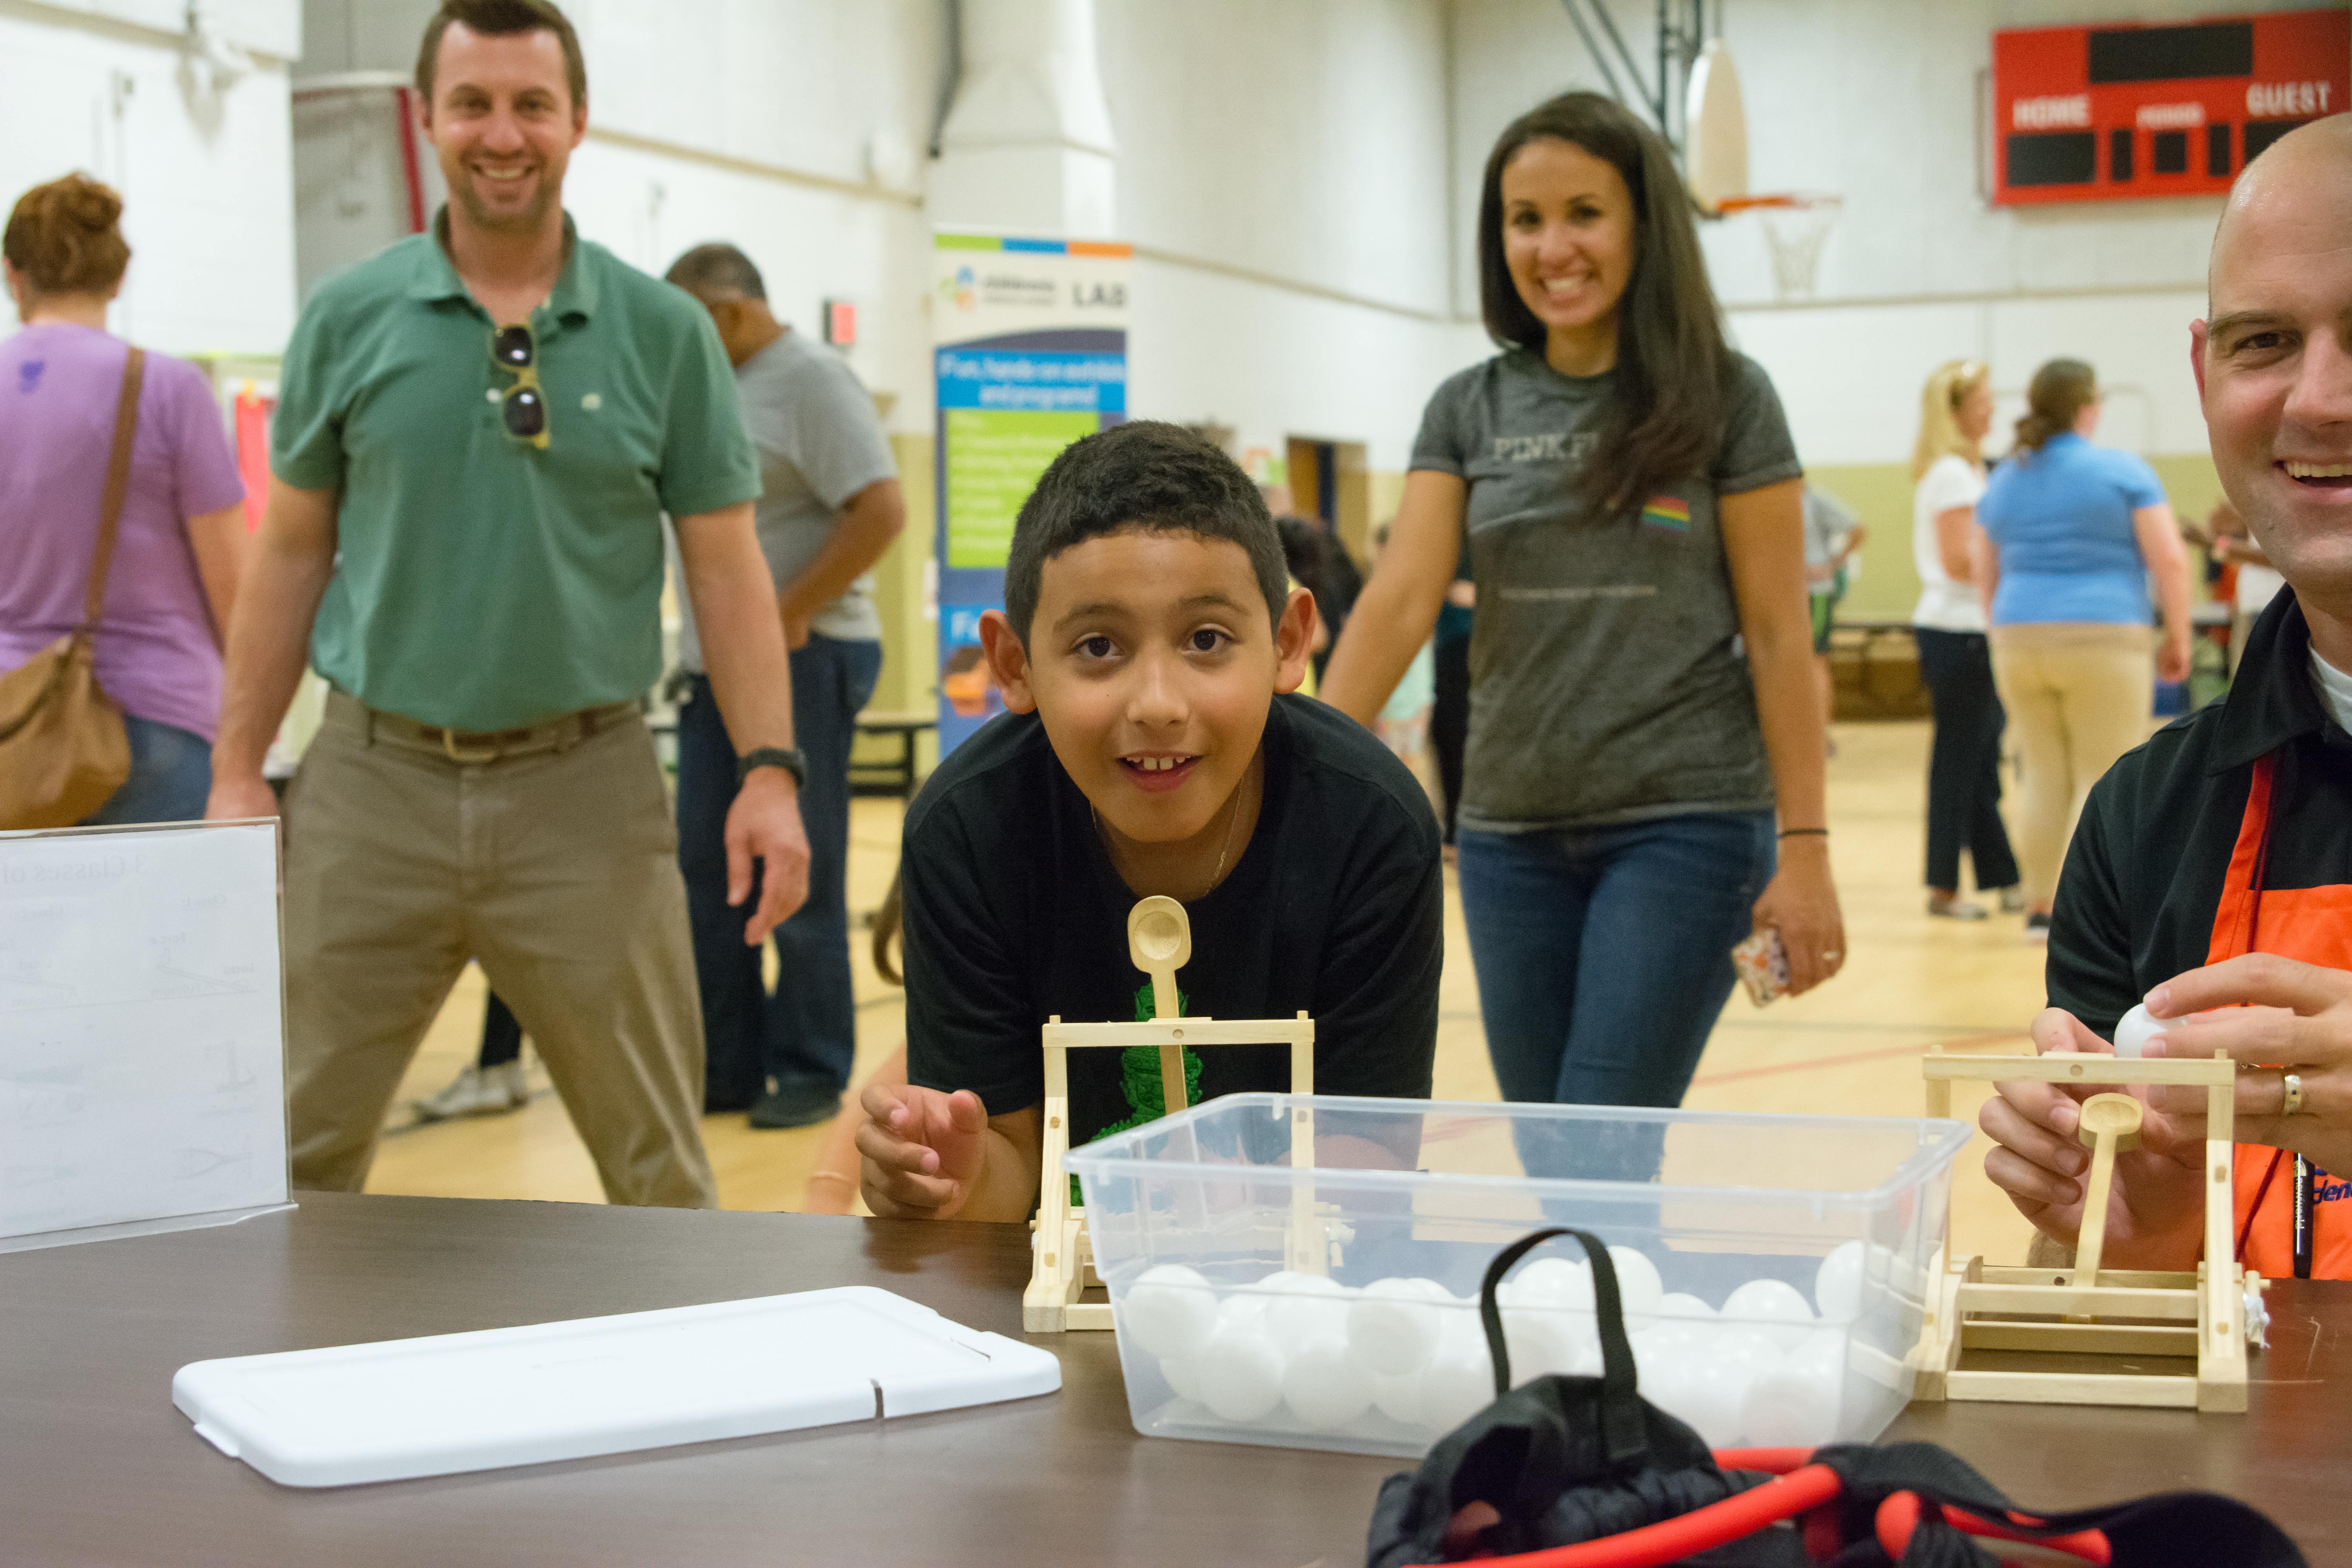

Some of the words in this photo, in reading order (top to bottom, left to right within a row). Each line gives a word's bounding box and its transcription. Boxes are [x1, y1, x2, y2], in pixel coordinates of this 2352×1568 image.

[2014, 96, 2090, 127] HOME
[2247, 82, 2331, 115] GUEST
[1073, 282, 1126, 307] LAB
[1493, 435, 1568, 461] PINK
[2313, 1179, 2352, 1205] den
